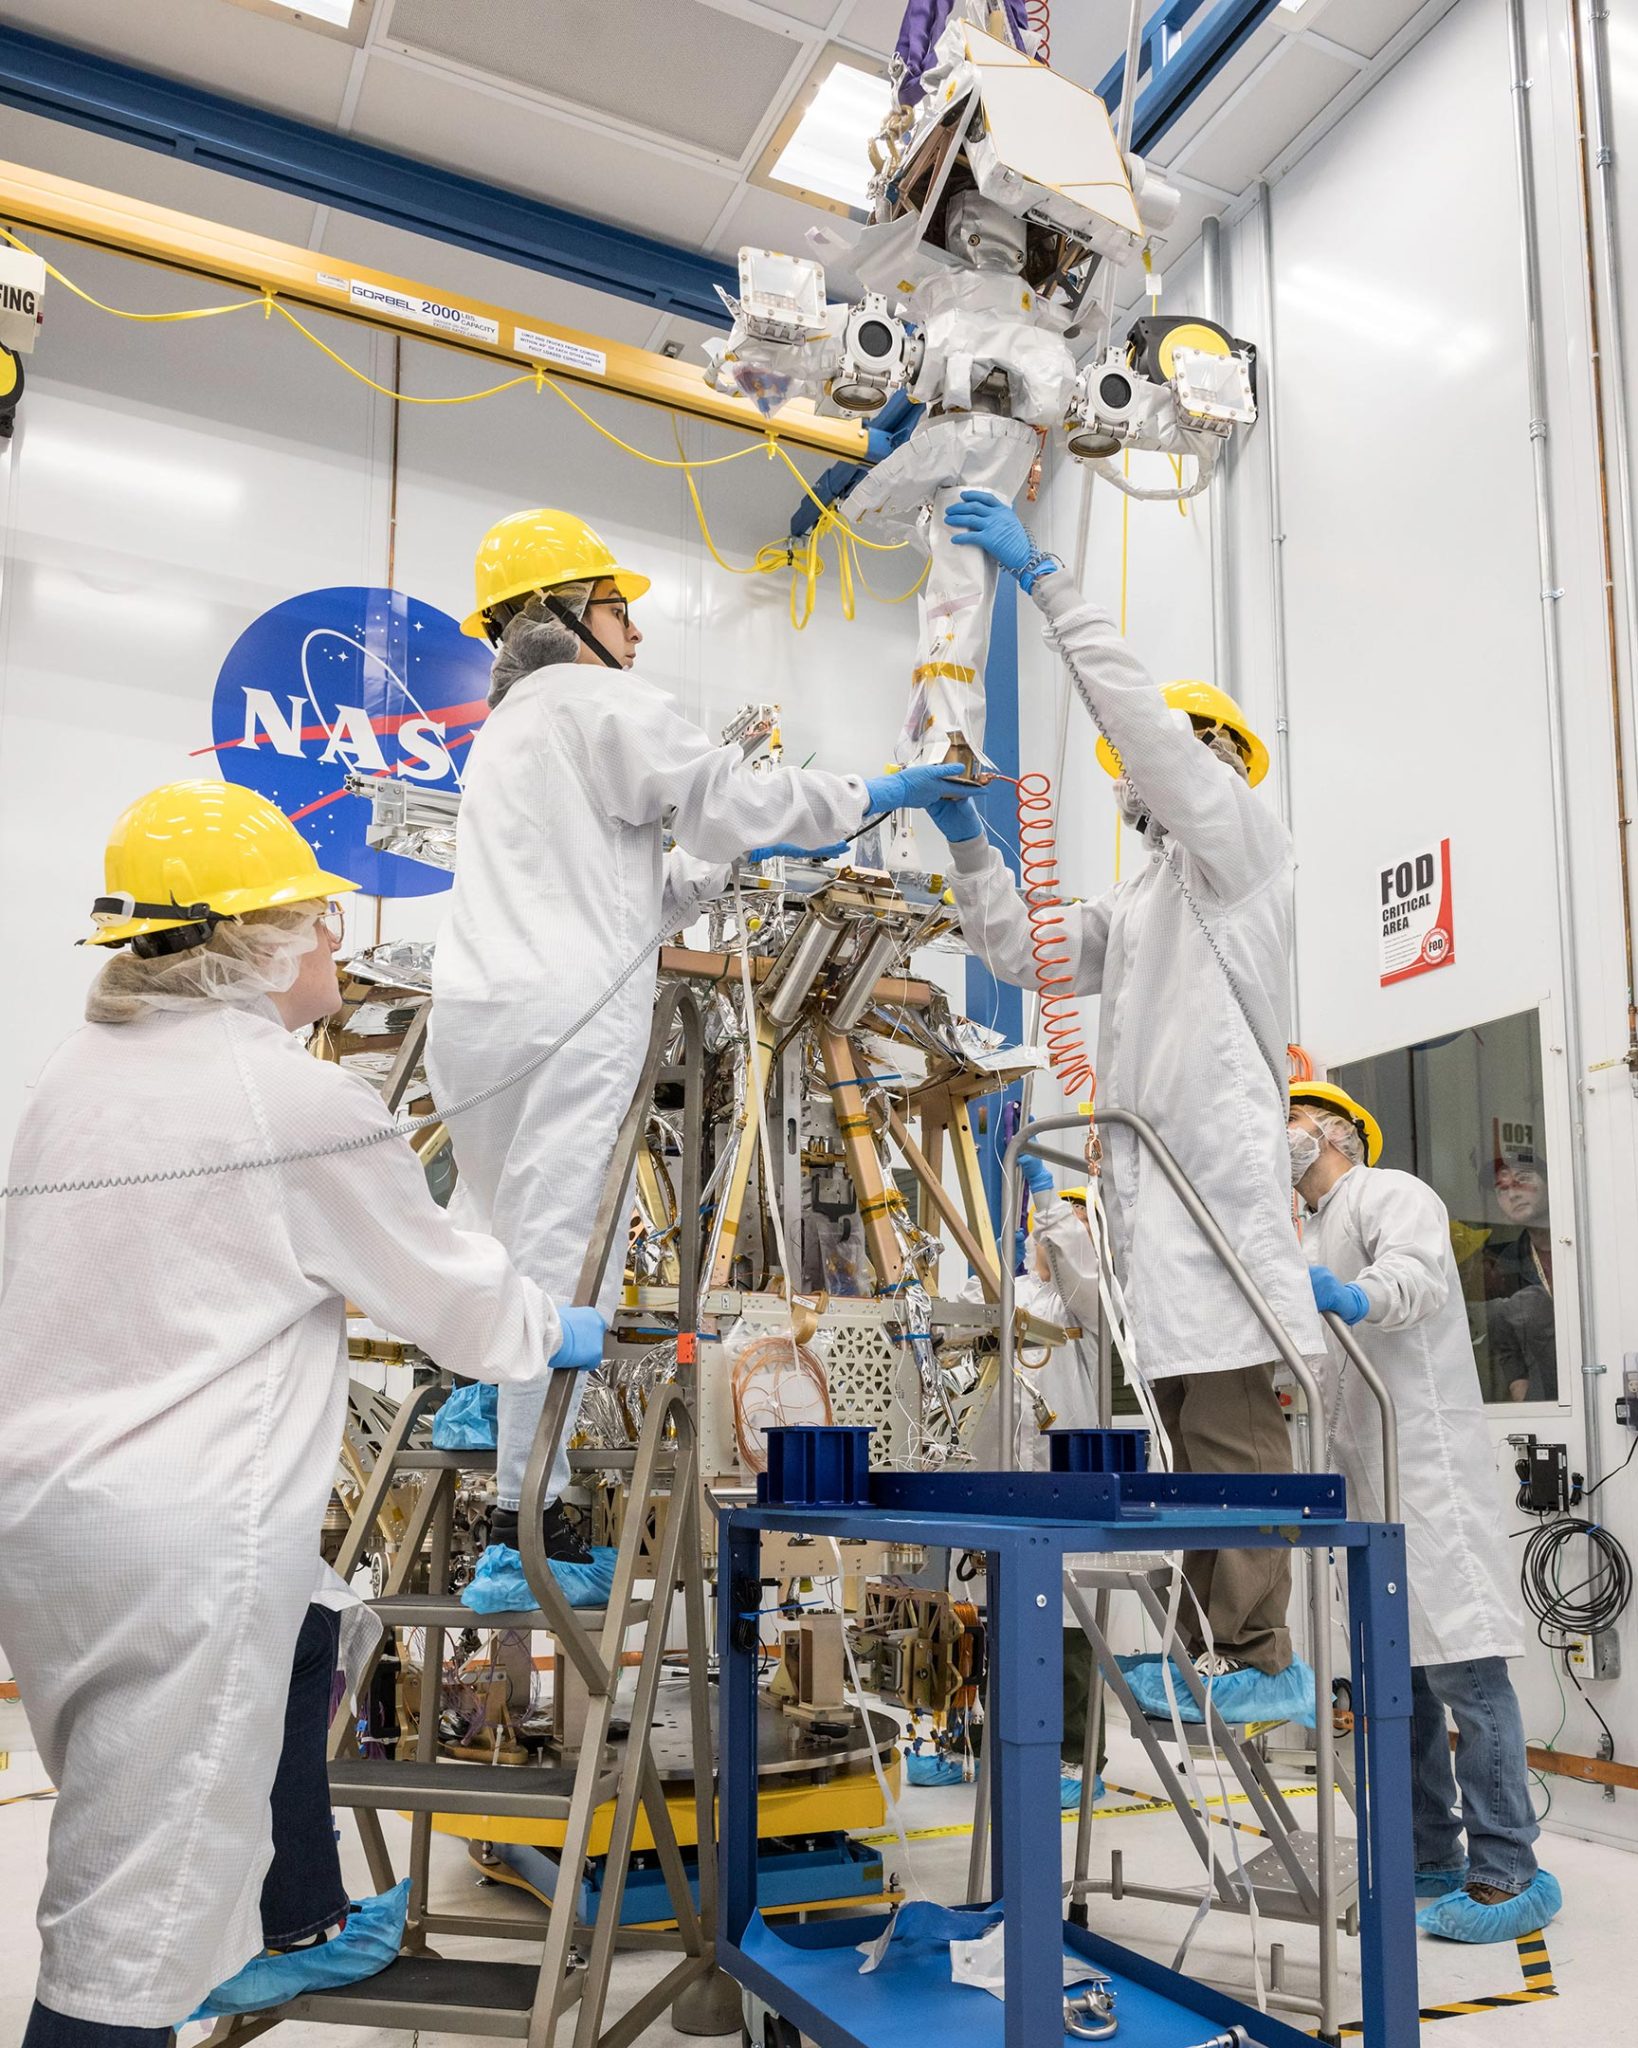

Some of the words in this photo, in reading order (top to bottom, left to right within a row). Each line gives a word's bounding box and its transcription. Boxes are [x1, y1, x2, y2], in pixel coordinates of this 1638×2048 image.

[0, 284, 35, 315] ING
[352, 286, 416, 311] GORBEL
[422, 301, 460, 322] 2000
[461, 320, 495, 334] CAPACITY
[1381, 853, 1434, 906] FOD
[1382, 893, 1431, 922] CRITICAL
[1383, 916, 1409, 937] AREA
[1429, 939, 1443, 952] FOD
